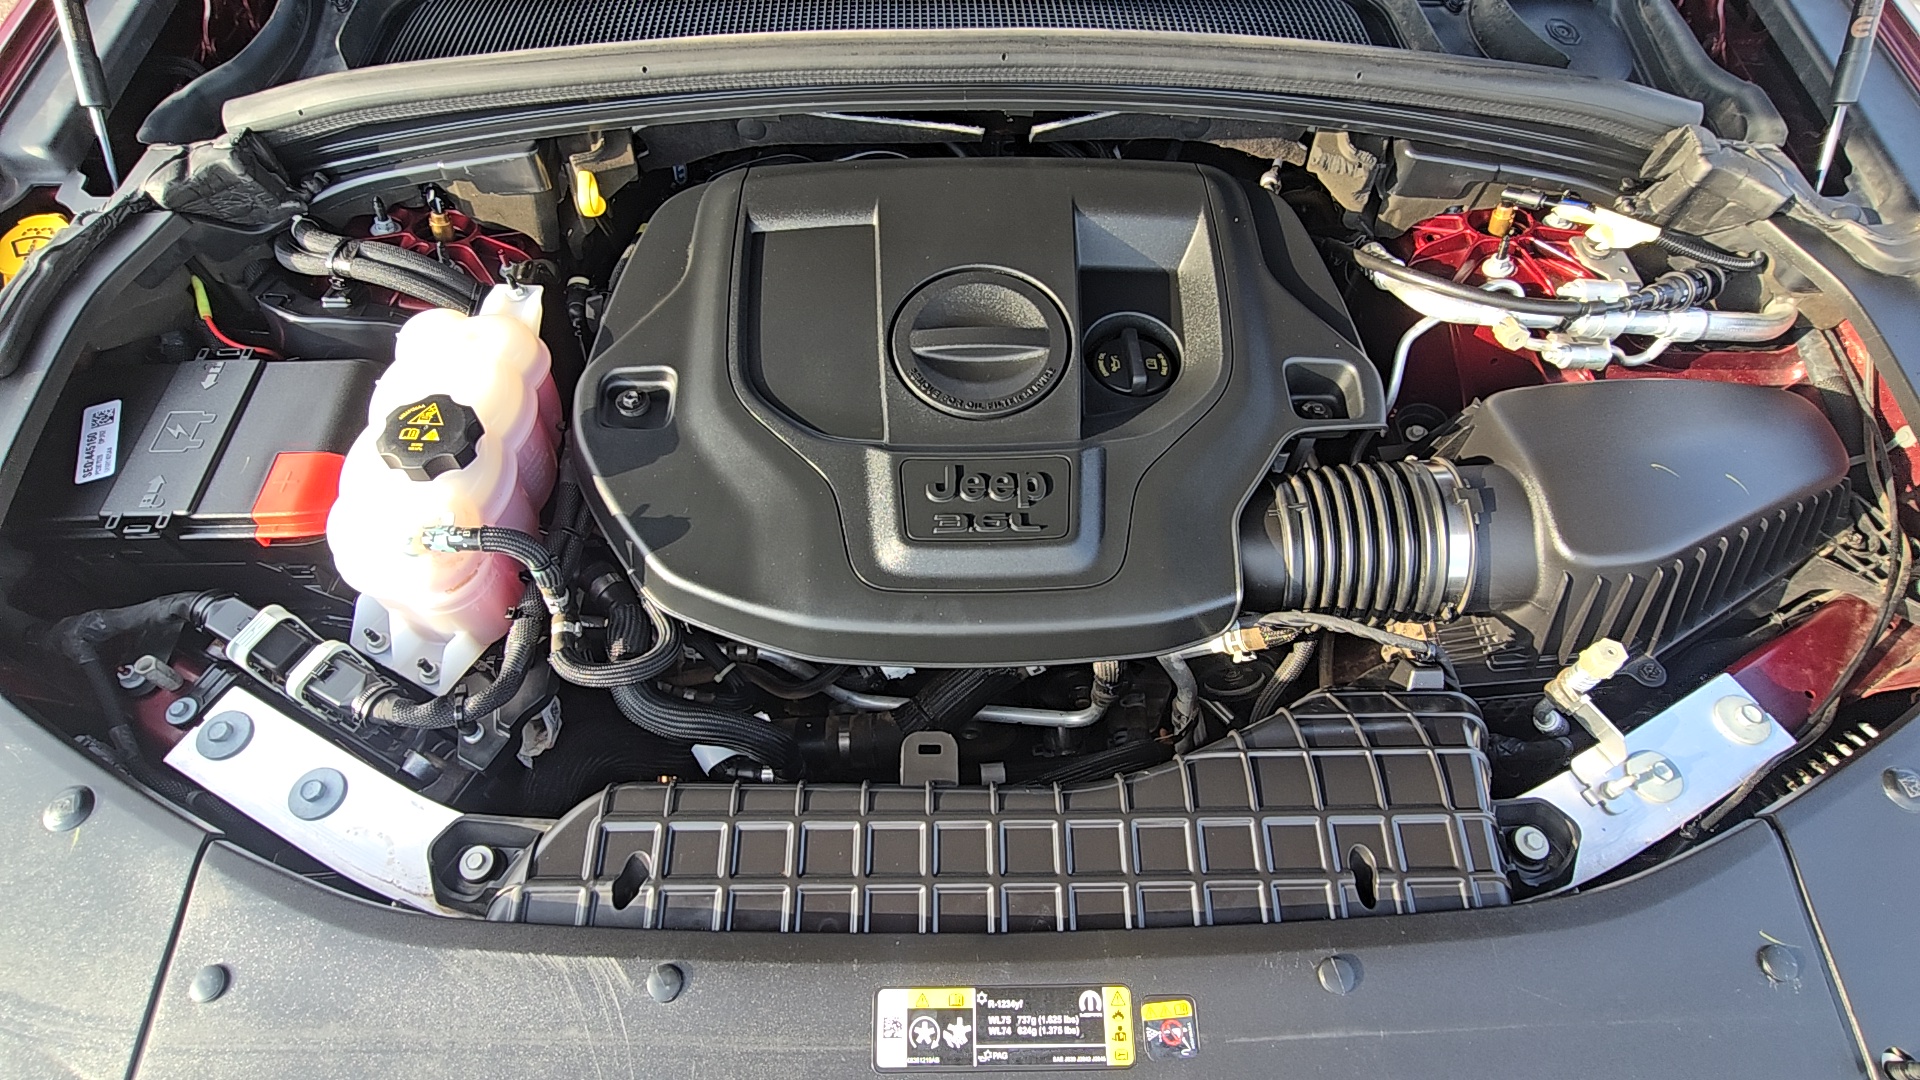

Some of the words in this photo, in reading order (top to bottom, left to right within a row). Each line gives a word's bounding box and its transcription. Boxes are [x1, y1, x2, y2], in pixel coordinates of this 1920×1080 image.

[907, 367, 942, 398] REMOVE
[940, 394, 963, 408] FOR
[965, 401, 985, 410] OIL
[926, 465, 1053, 508] Jeep
[933, 513, 1047, 533] 3.6L
[987, 999, 1024, 1010] R-1234yf
[987, 1015, 1012, 1025] WL75
[1016, 1015, 1037, 1026] 737g
[1063, 1015, 1080, 1025] lbs)
[987, 1026, 1012, 1036] WL74
[1064, 1026, 1081, 1037] lbs)
[992, 1052, 1008, 1060] PAG
